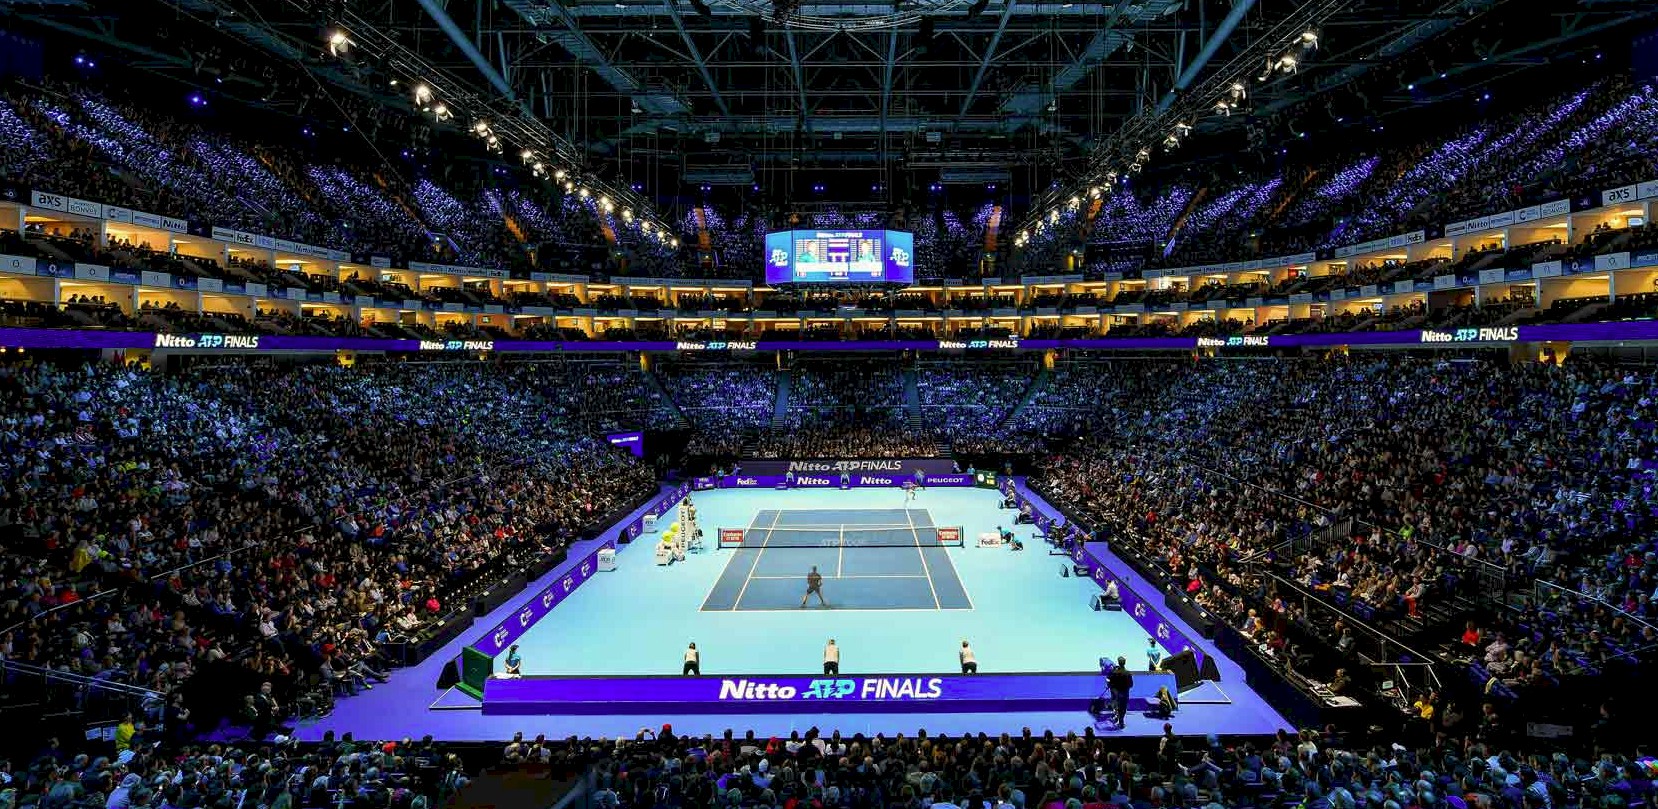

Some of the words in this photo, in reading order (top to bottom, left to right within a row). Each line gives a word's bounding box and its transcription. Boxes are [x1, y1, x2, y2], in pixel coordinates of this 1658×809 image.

[1609, 188, 1630, 201] axs
[39, 194, 62, 207] axs
[1467, 220, 1488, 229] Nitto
[1421, 330, 1452, 342] Nitto
[1454, 329, 1478, 341] ATP
[1479, 327, 1519, 341] FINALS
[156, 334, 195, 348] Nitto
[197, 334, 222, 347] ATP
[224, 335, 259, 348] FINALS
[420, 340, 445, 350] Nitto
[445, 340, 463, 349] ATP
[463, 340, 494, 350] FINALS
[677, 342, 705, 350] Nitto
[727, 341, 756, 349] FINALS
[940, 341, 967, 349] Nitto
[968, 340, 988, 348] ATP
[988, 340, 1018, 348] FINALS
[1197, 337, 1225, 346] Nitto
[1226, 336, 1243, 345] ATP
[1243, 335, 1269, 346] FINALS
[789, 461, 830, 471] Nitto
[860, 460, 902, 470] FINALS
[797, 477, 830, 485] Nitto
[860, 476, 892, 485] Nitto
[719, 679, 797, 700] Nitto
[802, 679, 856, 699] ATP
[861, 678, 943, 699] FINALS
